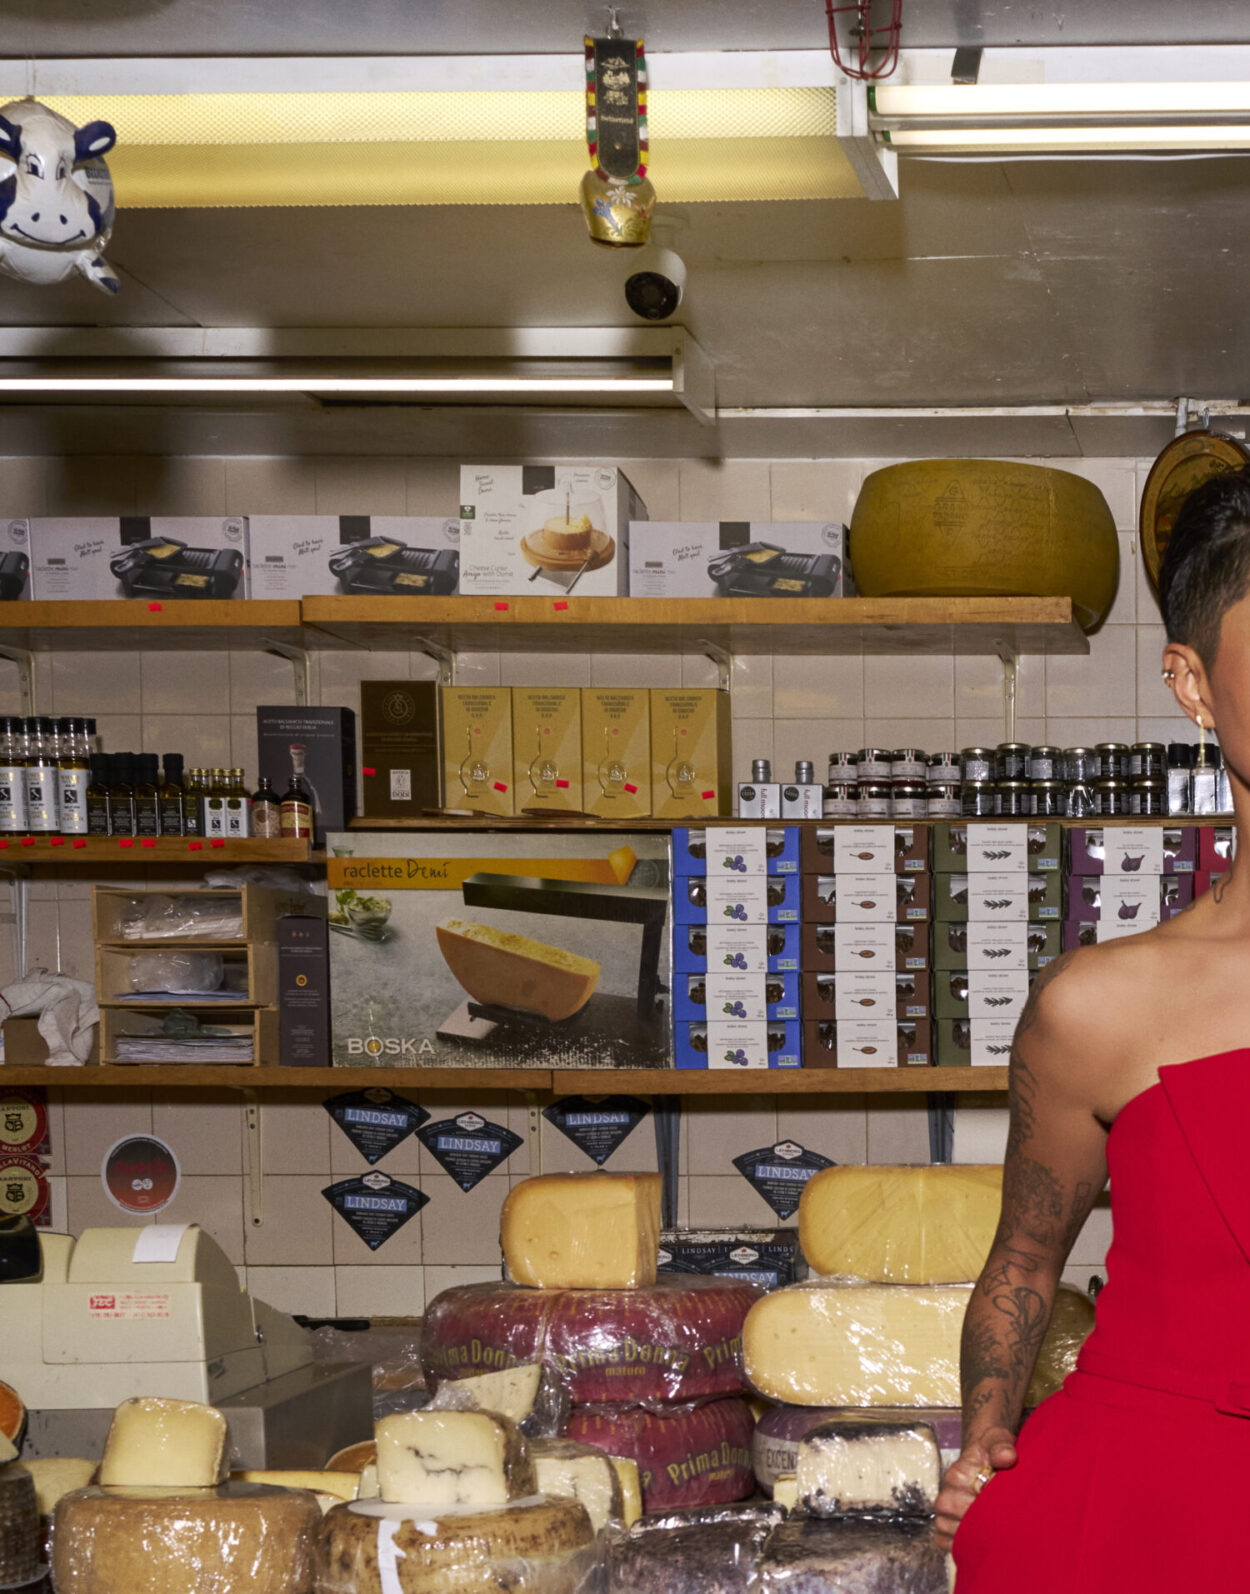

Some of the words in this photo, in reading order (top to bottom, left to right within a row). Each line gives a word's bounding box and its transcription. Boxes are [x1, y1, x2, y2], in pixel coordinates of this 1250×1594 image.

[343, 860, 402, 879] raclette
[406, 859, 451, 879] Demi
[348, 1037, 436, 1057] BOSKA
[347, 1108, 407, 1126] LINDSAY
[568, 1112, 626, 1125] LINDSAY
[2, 1143, 32, 1152] MERLOT
[439, 1137, 500, 1152] LINDSAY
[347, 1196, 405, 1211] LINDSAY
[682, 1247, 716, 1255] LINDSAY
[604, 1366, 646, 1377] maturo
[667, 1449, 718, 1485] Prima
